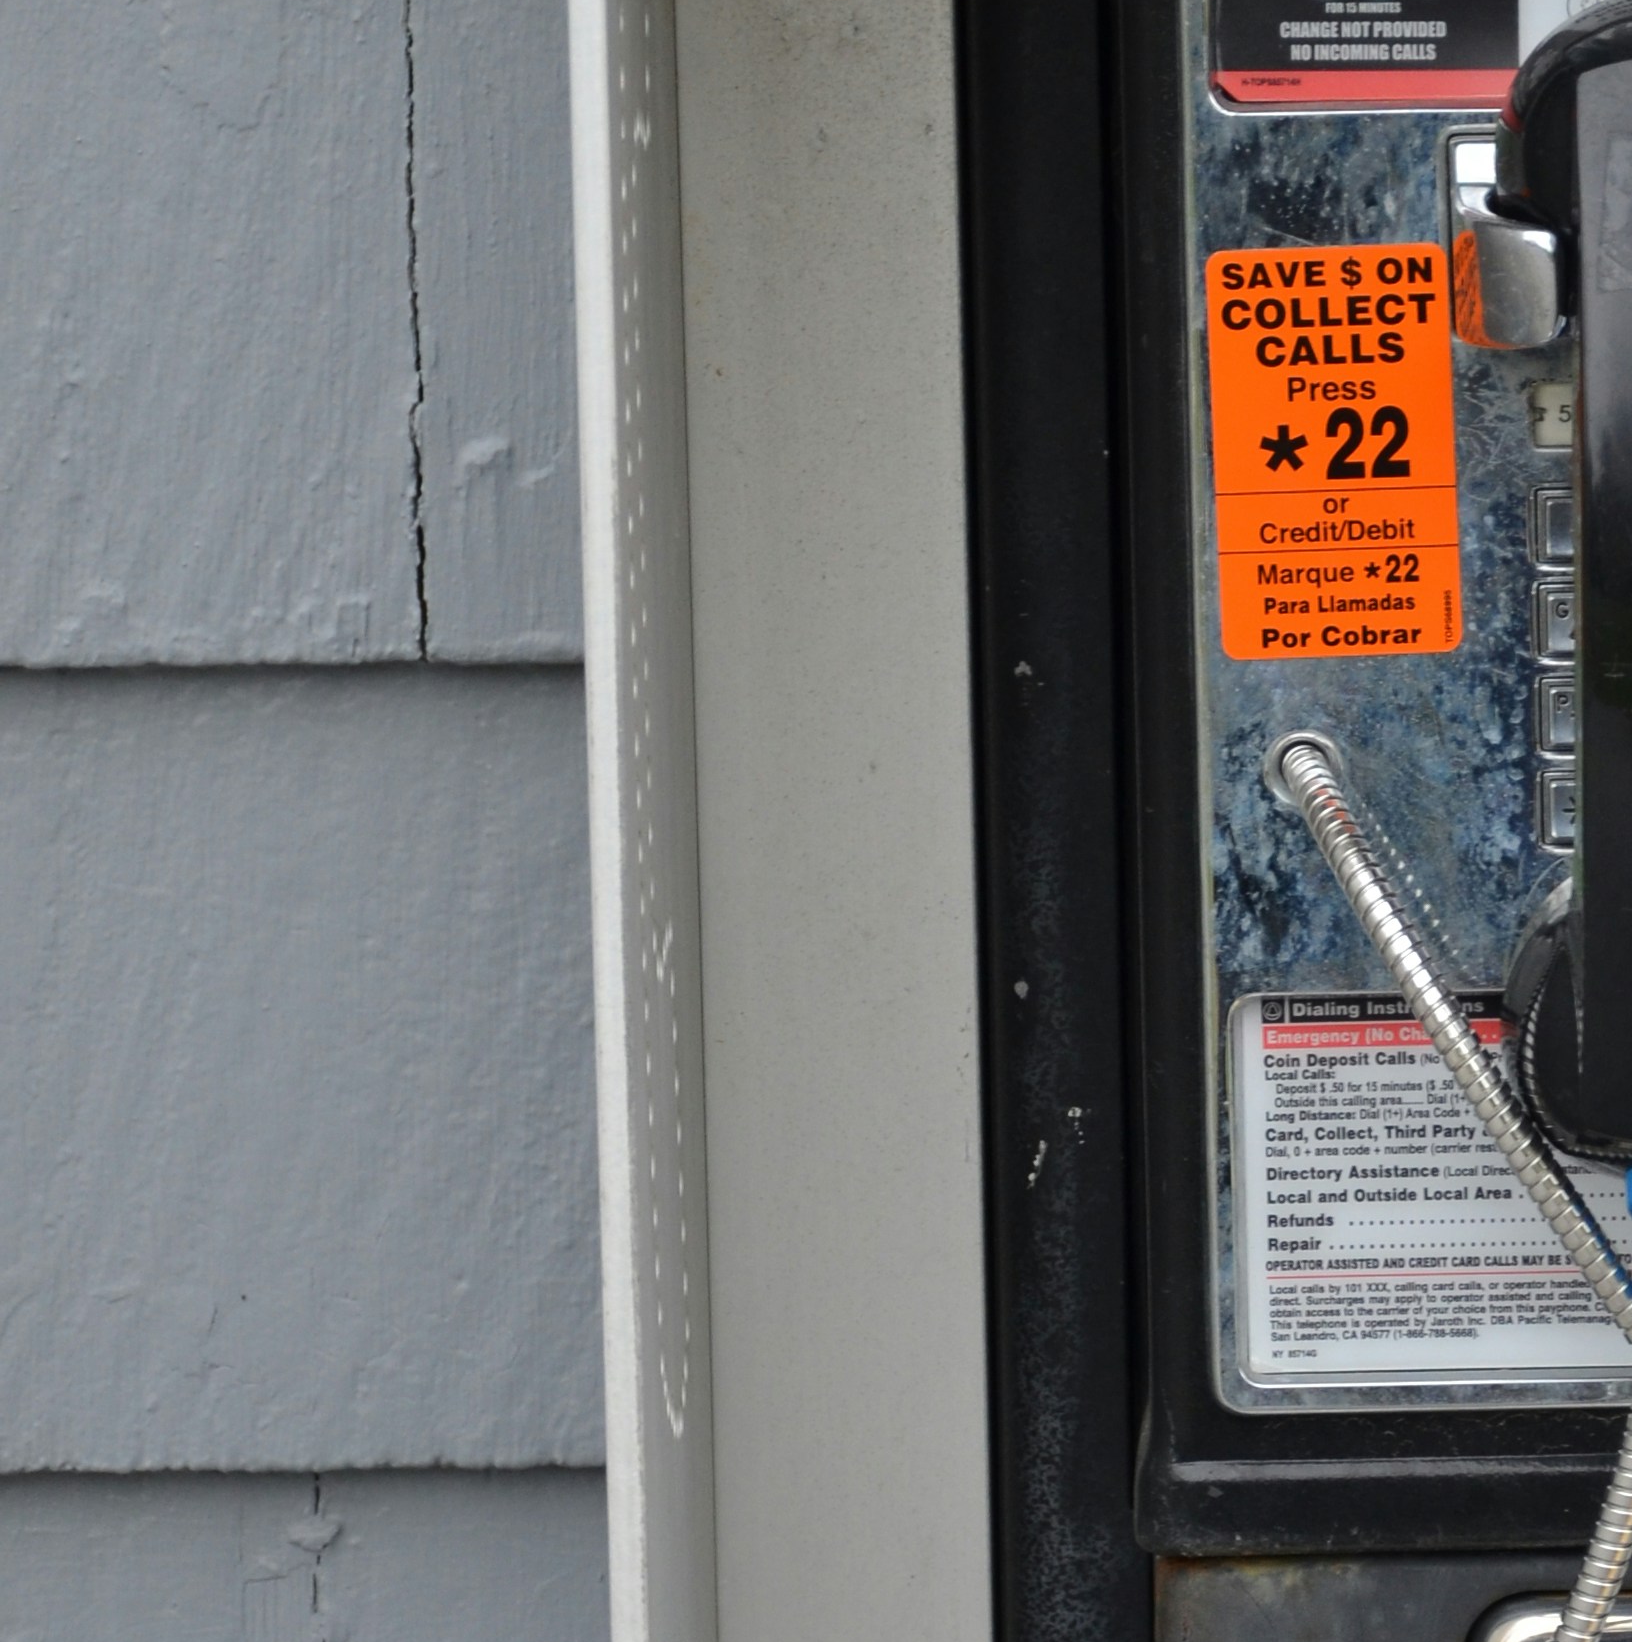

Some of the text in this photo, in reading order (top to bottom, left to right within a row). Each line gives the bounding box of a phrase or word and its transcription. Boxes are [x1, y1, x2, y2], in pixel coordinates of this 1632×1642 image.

[1325, 2, 1402, 14] FOR 15 MINUTES
[1280, 21, 1447, 39] CHANGE NOT PROVIDED
[1290, 44, 1437, 61] NO INCOMING CALLS
[1221, 256, 1433, 291] SAVE $ ON
[1221, 292, 1435, 331] COLLECT
[1255, 332, 1405, 368] CALLS
[1287, 376, 1377, 402] Press
[1322, 496, 1350, 515] or
[1259, 519, 1415, 545] Credit/Debit
[1257, 563, 1355, 589] Marque
[1264, 594, 1416, 615] Para Llamadas
[1261, 624, 1422, 649] Por Cobrar
[1292, 1002, 1361, 1018] Dialing
[1266, 1027, 1394, 1046] Emergency (No
[1264, 1051, 1417, 1069] Coin Deposit Calls
[1265, 1068, 1336, 1081] Local Calls:
[1265, 1124, 1477, 1143] Card, Collect, Third Party
[1266, 1164, 1440, 1183] Directory Assistance
[1267, 1186, 1513, 1205] Local and Outside Local Area
[1267, 1213, 1335, 1229] Refunds
[1268, 1237, 1323, 1254] Repair
